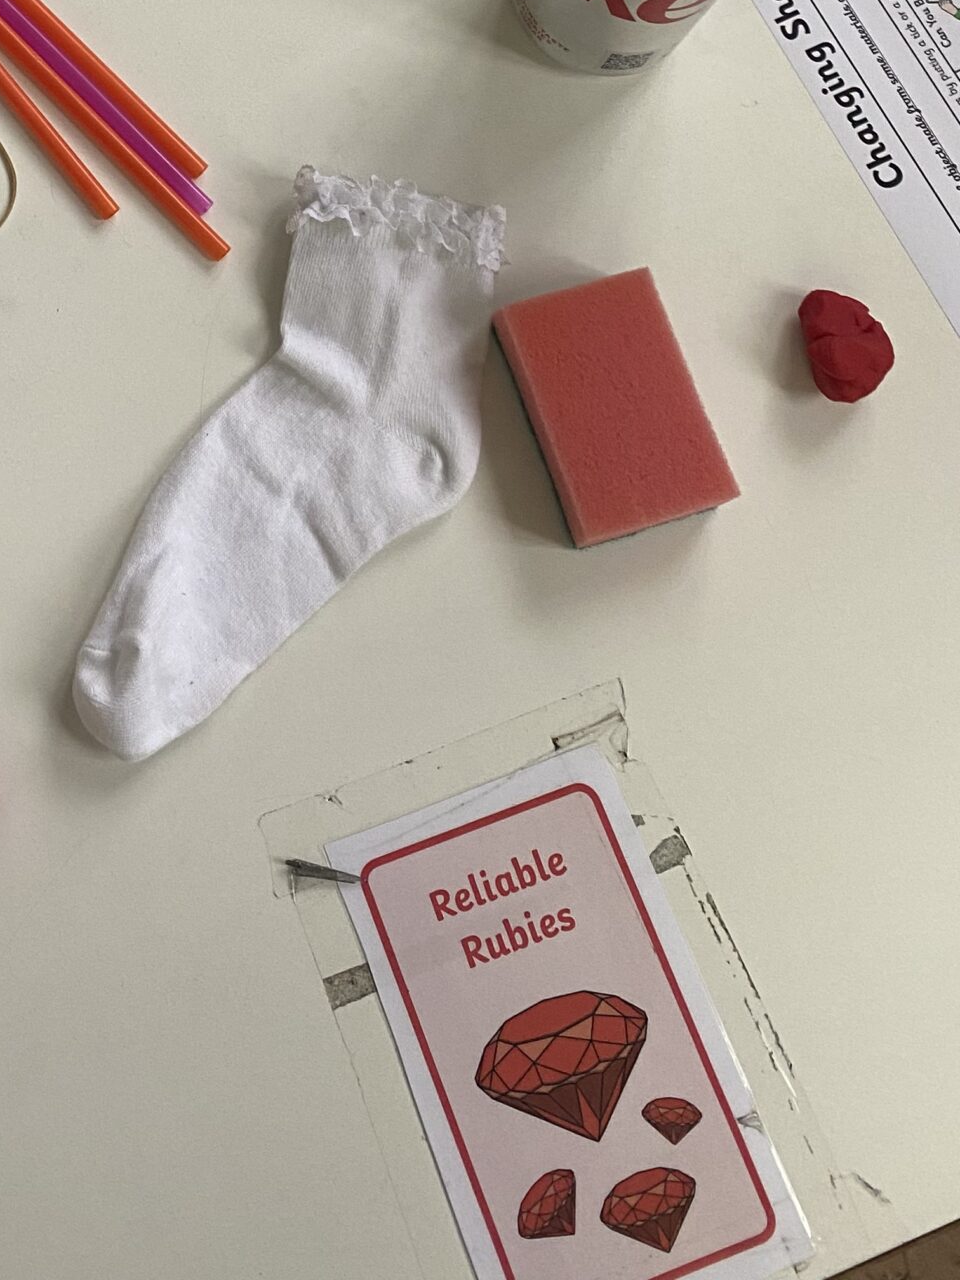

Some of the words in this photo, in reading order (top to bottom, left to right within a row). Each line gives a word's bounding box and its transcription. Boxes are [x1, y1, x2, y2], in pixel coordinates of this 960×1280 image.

[842, 1, 882, 56] materials
[904, 21, 921, 40] tick
[922, 6, 938, 29] You
[935, 26, 953, 49] Can
[875, 53, 901, 86] some
[922, 47, 953, 83] putting
[804, 41, 904, 189] Changing
[895, 83, 921, 115] from
[914, 112, 941, 147] made
[934, 145, 960, 182] object
[428, 848, 568, 922] Reliable
[460, 907, 577, 969] Rubies
